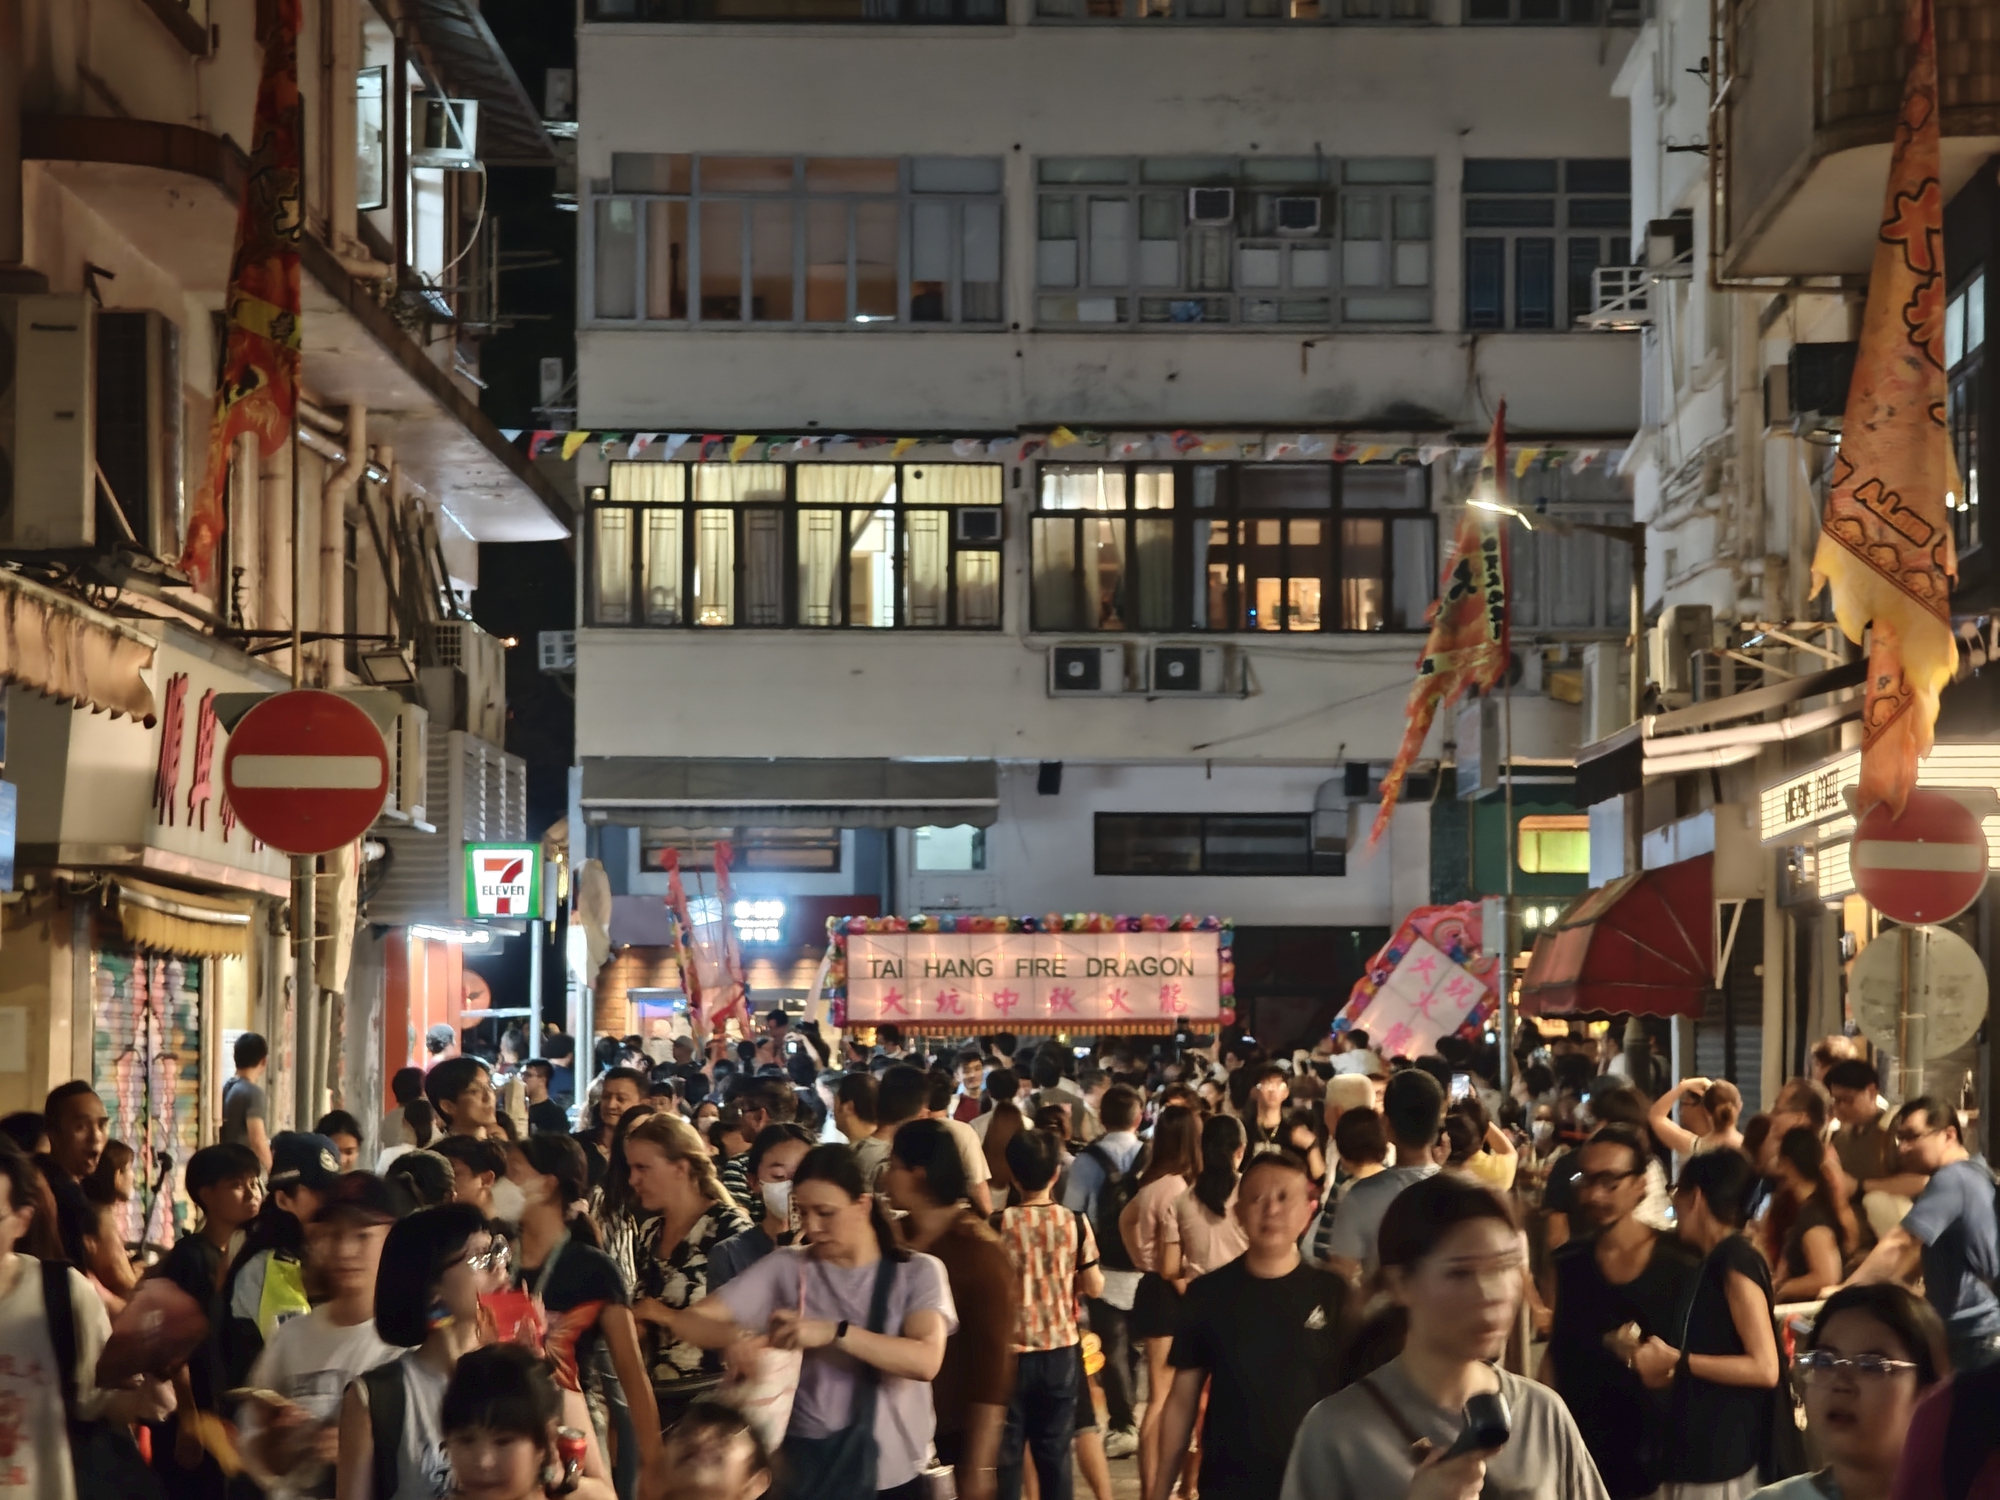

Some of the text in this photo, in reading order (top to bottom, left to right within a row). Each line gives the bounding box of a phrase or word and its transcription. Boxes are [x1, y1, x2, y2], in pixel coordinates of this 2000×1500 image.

[868, 957, 1194, 979] TAI HANG FIRE DRAGON
[880, 983, 1187, 1016] 大坑中秋火龍
